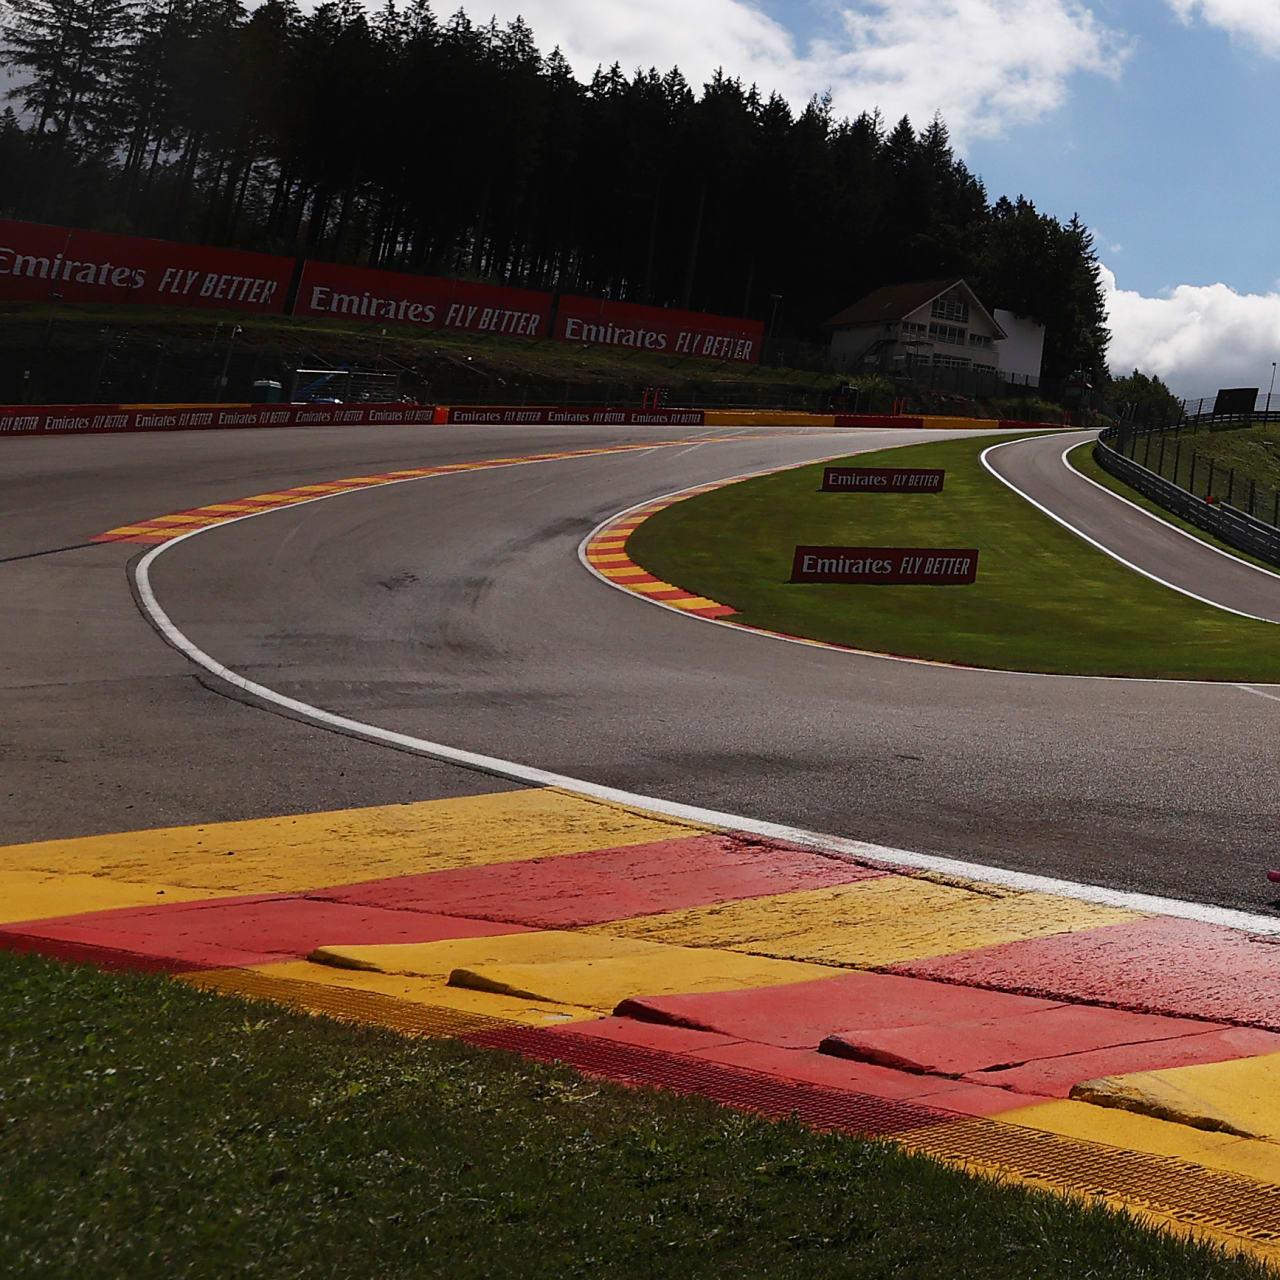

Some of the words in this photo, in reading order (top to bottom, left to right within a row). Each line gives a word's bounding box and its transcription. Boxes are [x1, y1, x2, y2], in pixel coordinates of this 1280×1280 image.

[157, 267, 200, 295] FLY
[199, 272, 278, 304] BETTER
[310, 285, 437, 323] Emirates
[444, 303, 479, 328] FLY
[478, 307, 541, 336] BETTER
[565, 317, 669, 350] Emirates
[674, 331, 702, 353] FLY
[702, 334, 753, 360] BETTER
[135, 413, 177, 427] Emirates
[218, 411, 258, 425] Emirates
[295, 410, 331, 423] Emirates
[368, 409, 403, 421] Emirates
[454, 410, 501, 422] Emirates
[548, 410, 590, 422] Emirates
[631, 412, 669, 423] Emirates
[45, 416, 90, 430] Emirates
[828, 473, 888, 487] Emirates
[891, 474, 909, 487] FLY
[909, 475, 940, 488] BETTER
[802, 554, 894, 574] Emirates
[900, 556, 924, 575] FLY
[924, 557, 972, 576] BETTER
